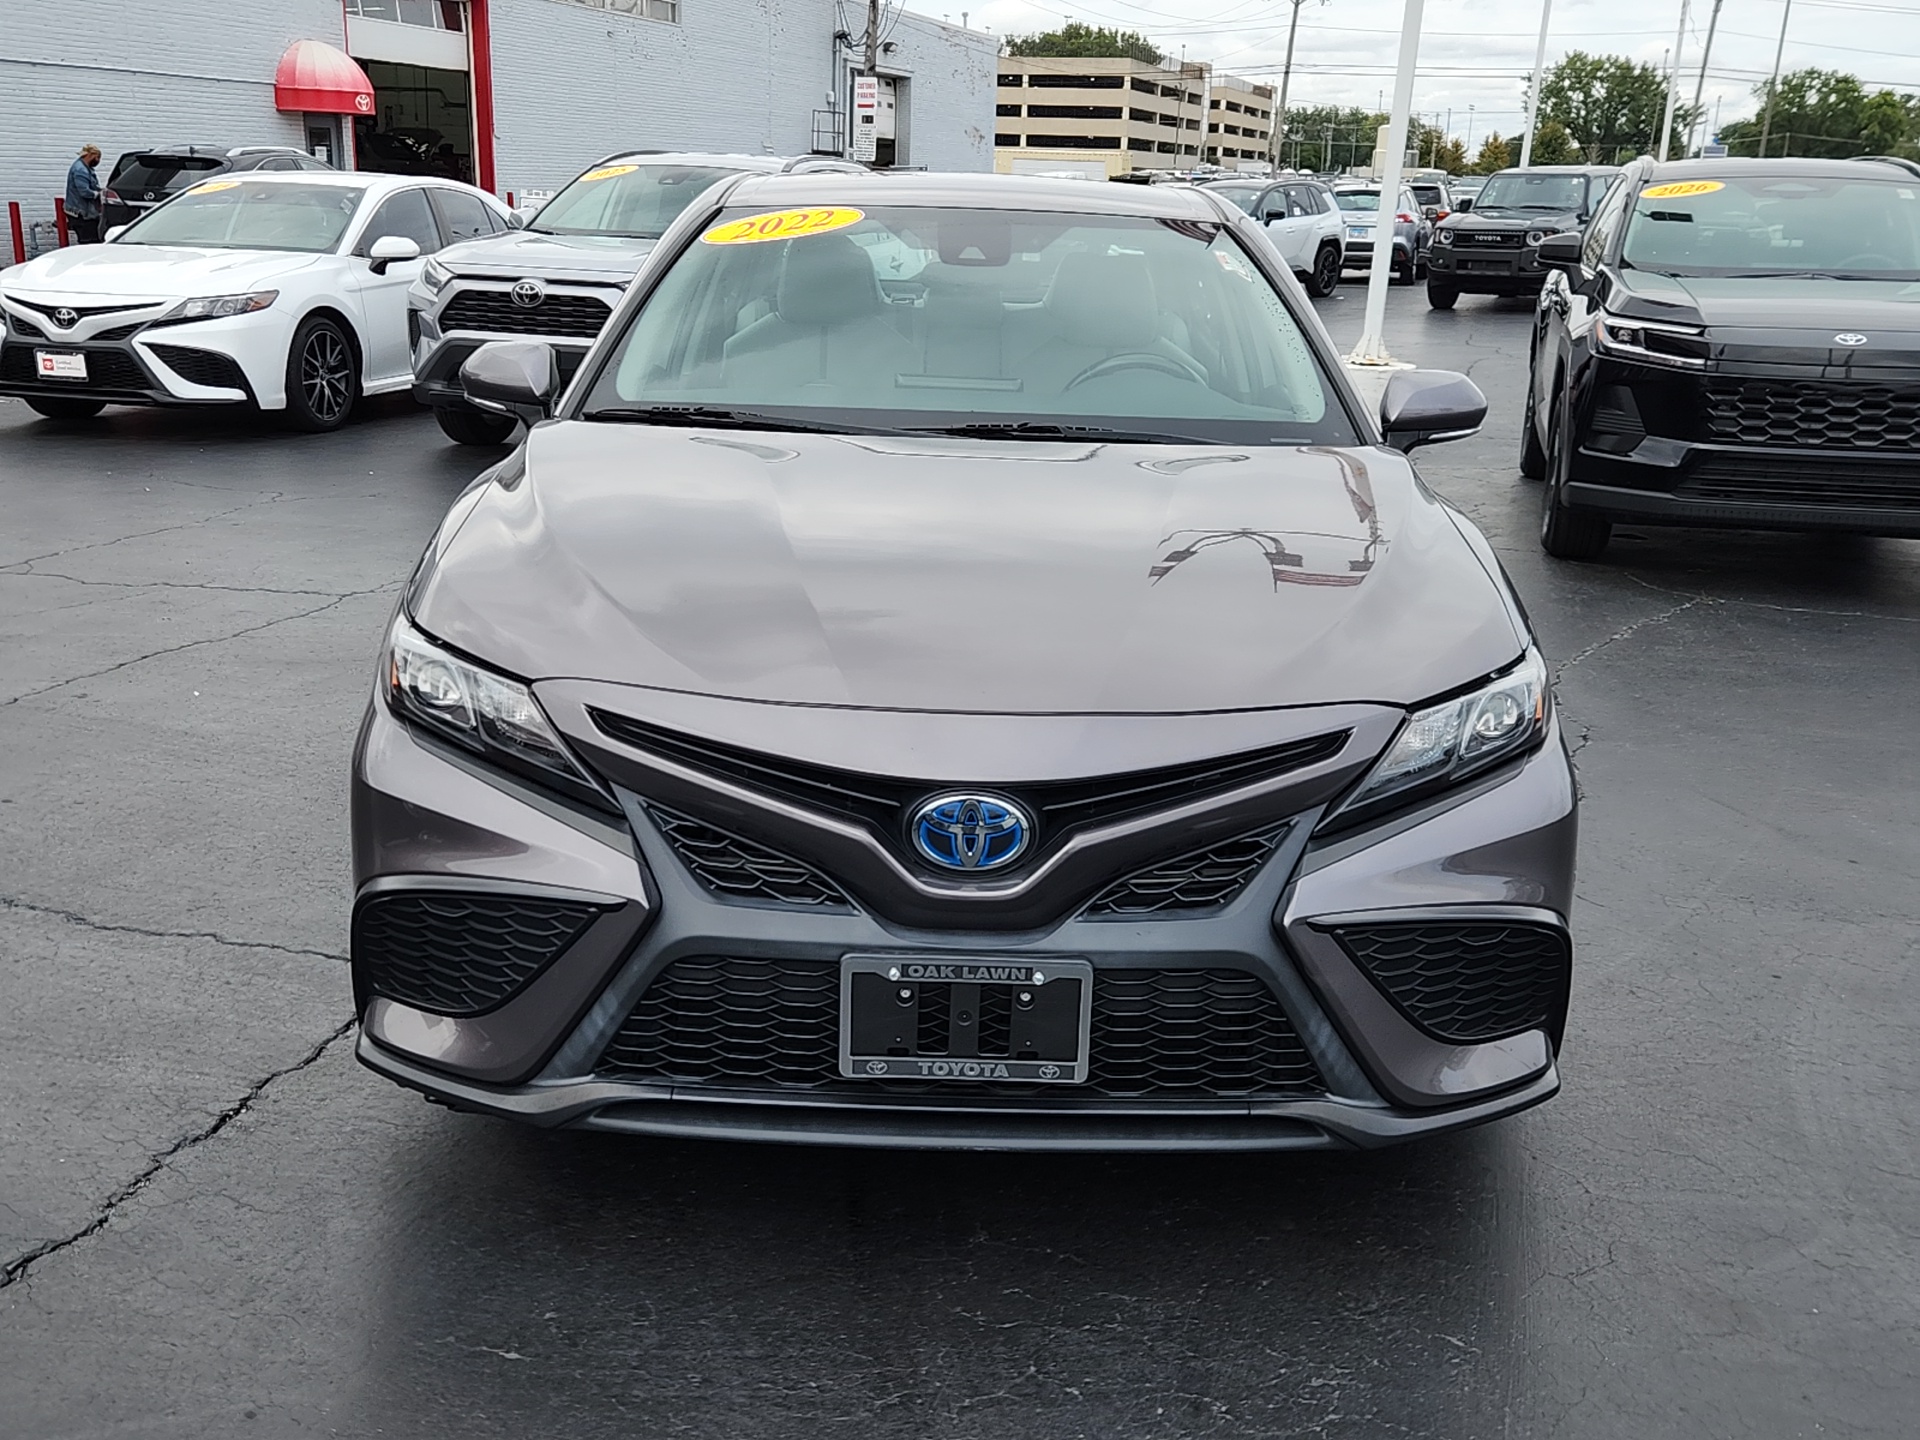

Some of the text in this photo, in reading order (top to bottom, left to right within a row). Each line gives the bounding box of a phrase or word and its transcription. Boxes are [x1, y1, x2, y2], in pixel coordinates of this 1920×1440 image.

[1655, 183, 1708, 196] 2026
[730, 210, 835, 241] 2022
[908, 965, 1026, 980] OAK LAWN
[918, 1062, 1010, 1077] TOYOTA
